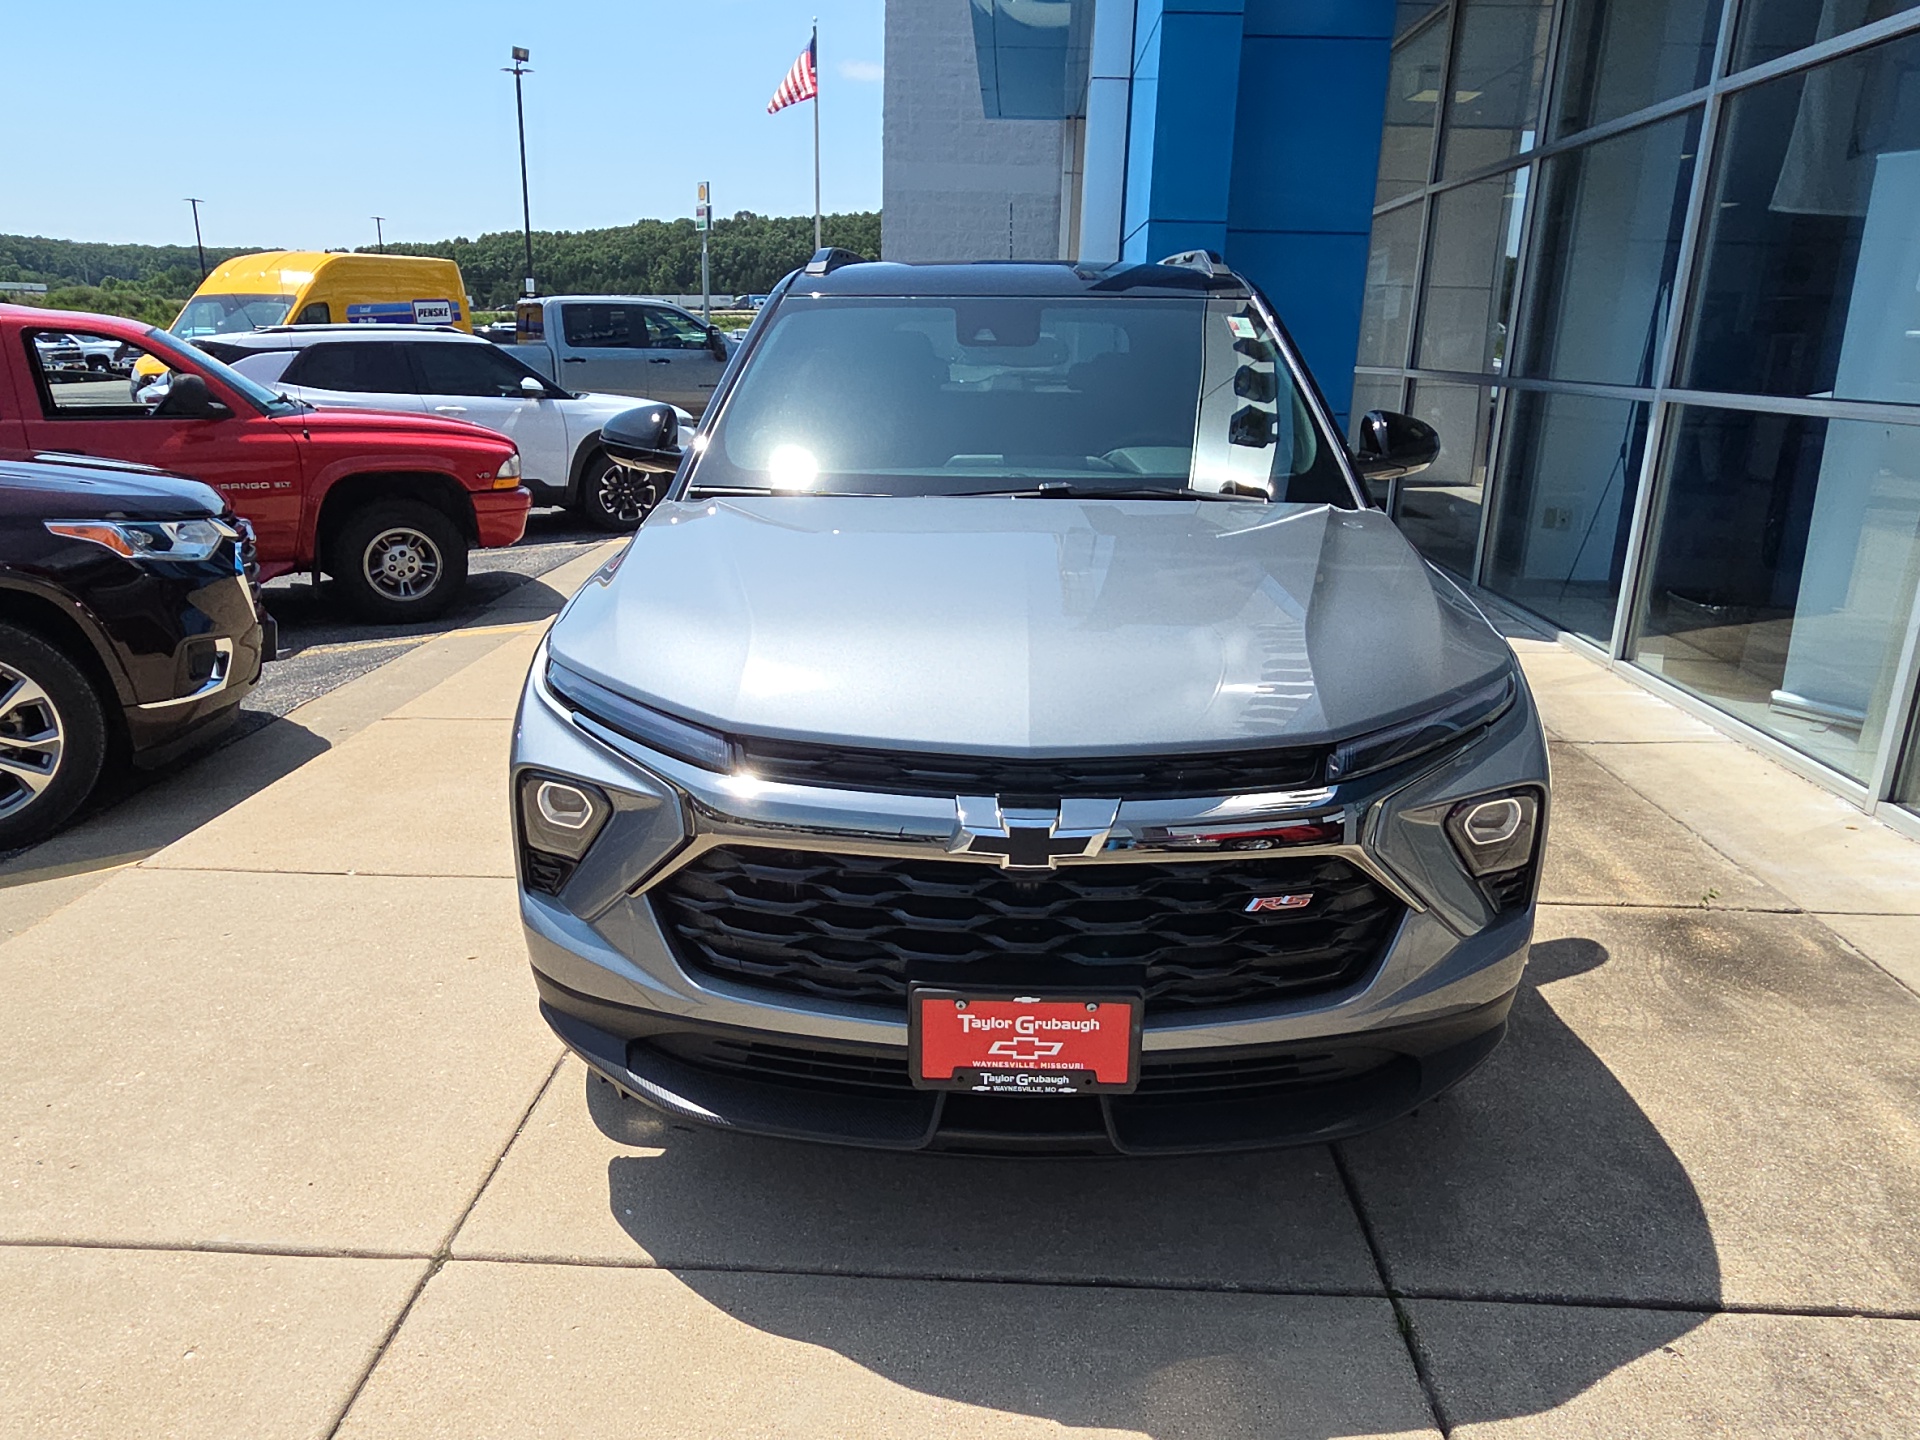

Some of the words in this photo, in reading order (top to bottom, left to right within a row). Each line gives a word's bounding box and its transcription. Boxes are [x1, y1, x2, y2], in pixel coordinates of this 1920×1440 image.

[418, 307, 449, 318] PENSKE
[1245, 893, 1313, 911] RS
[957, 1014, 1012, 1033] Taylor
[1015, 1016, 1100, 1034] Grubaugh
[972, 1061, 1038, 1069] WAYNESVILLE,
[980, 1072, 1015, 1085] Taylor
[1016, 1073, 1070, 1086] Grubaugh
[993, 1085, 1043, 1093] WAYNESVILLE,
